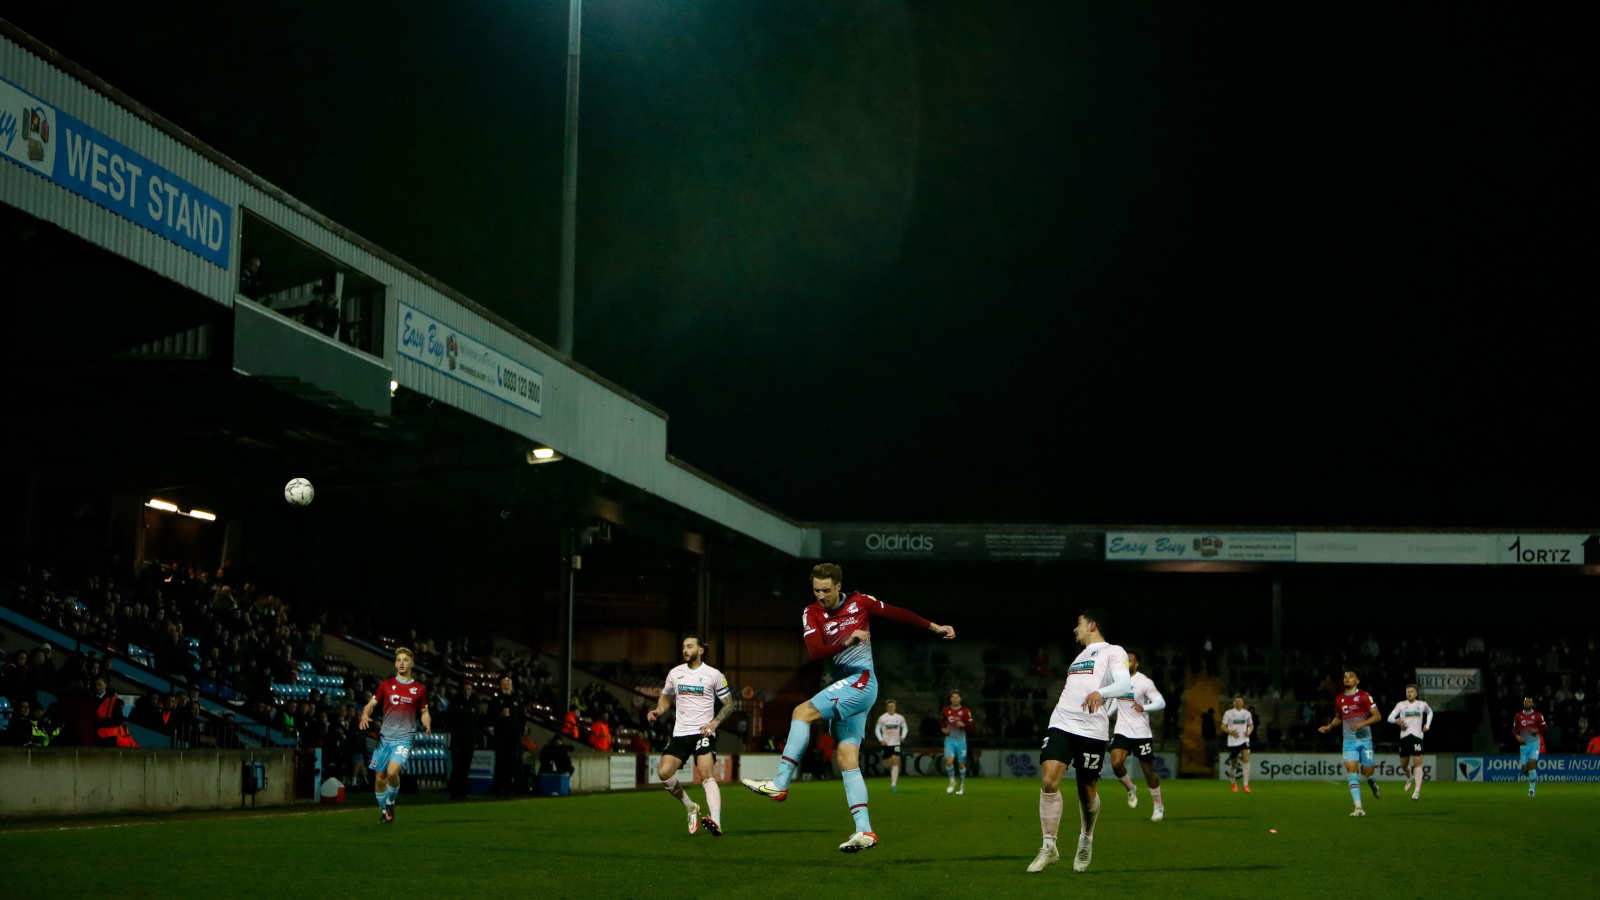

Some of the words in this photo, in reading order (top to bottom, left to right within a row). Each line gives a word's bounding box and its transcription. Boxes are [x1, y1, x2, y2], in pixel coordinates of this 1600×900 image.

[66, 128, 142, 208] WEST
[148, 175, 223, 251] STAND
[403, 312, 424, 356] Easy
[428, 324, 444, 366] Buy
[865, 533, 934, 551] Oldrids
[1109, 536, 1148, 555] Easy
[1155, 537, 1186, 556] Buy
[1138, 742, 1152, 756] 25
[1082, 752, 1100, 769] 12
[1260, 760, 1342, 778] Specialist
[1488, 759, 1565, 770] JOHNONE
